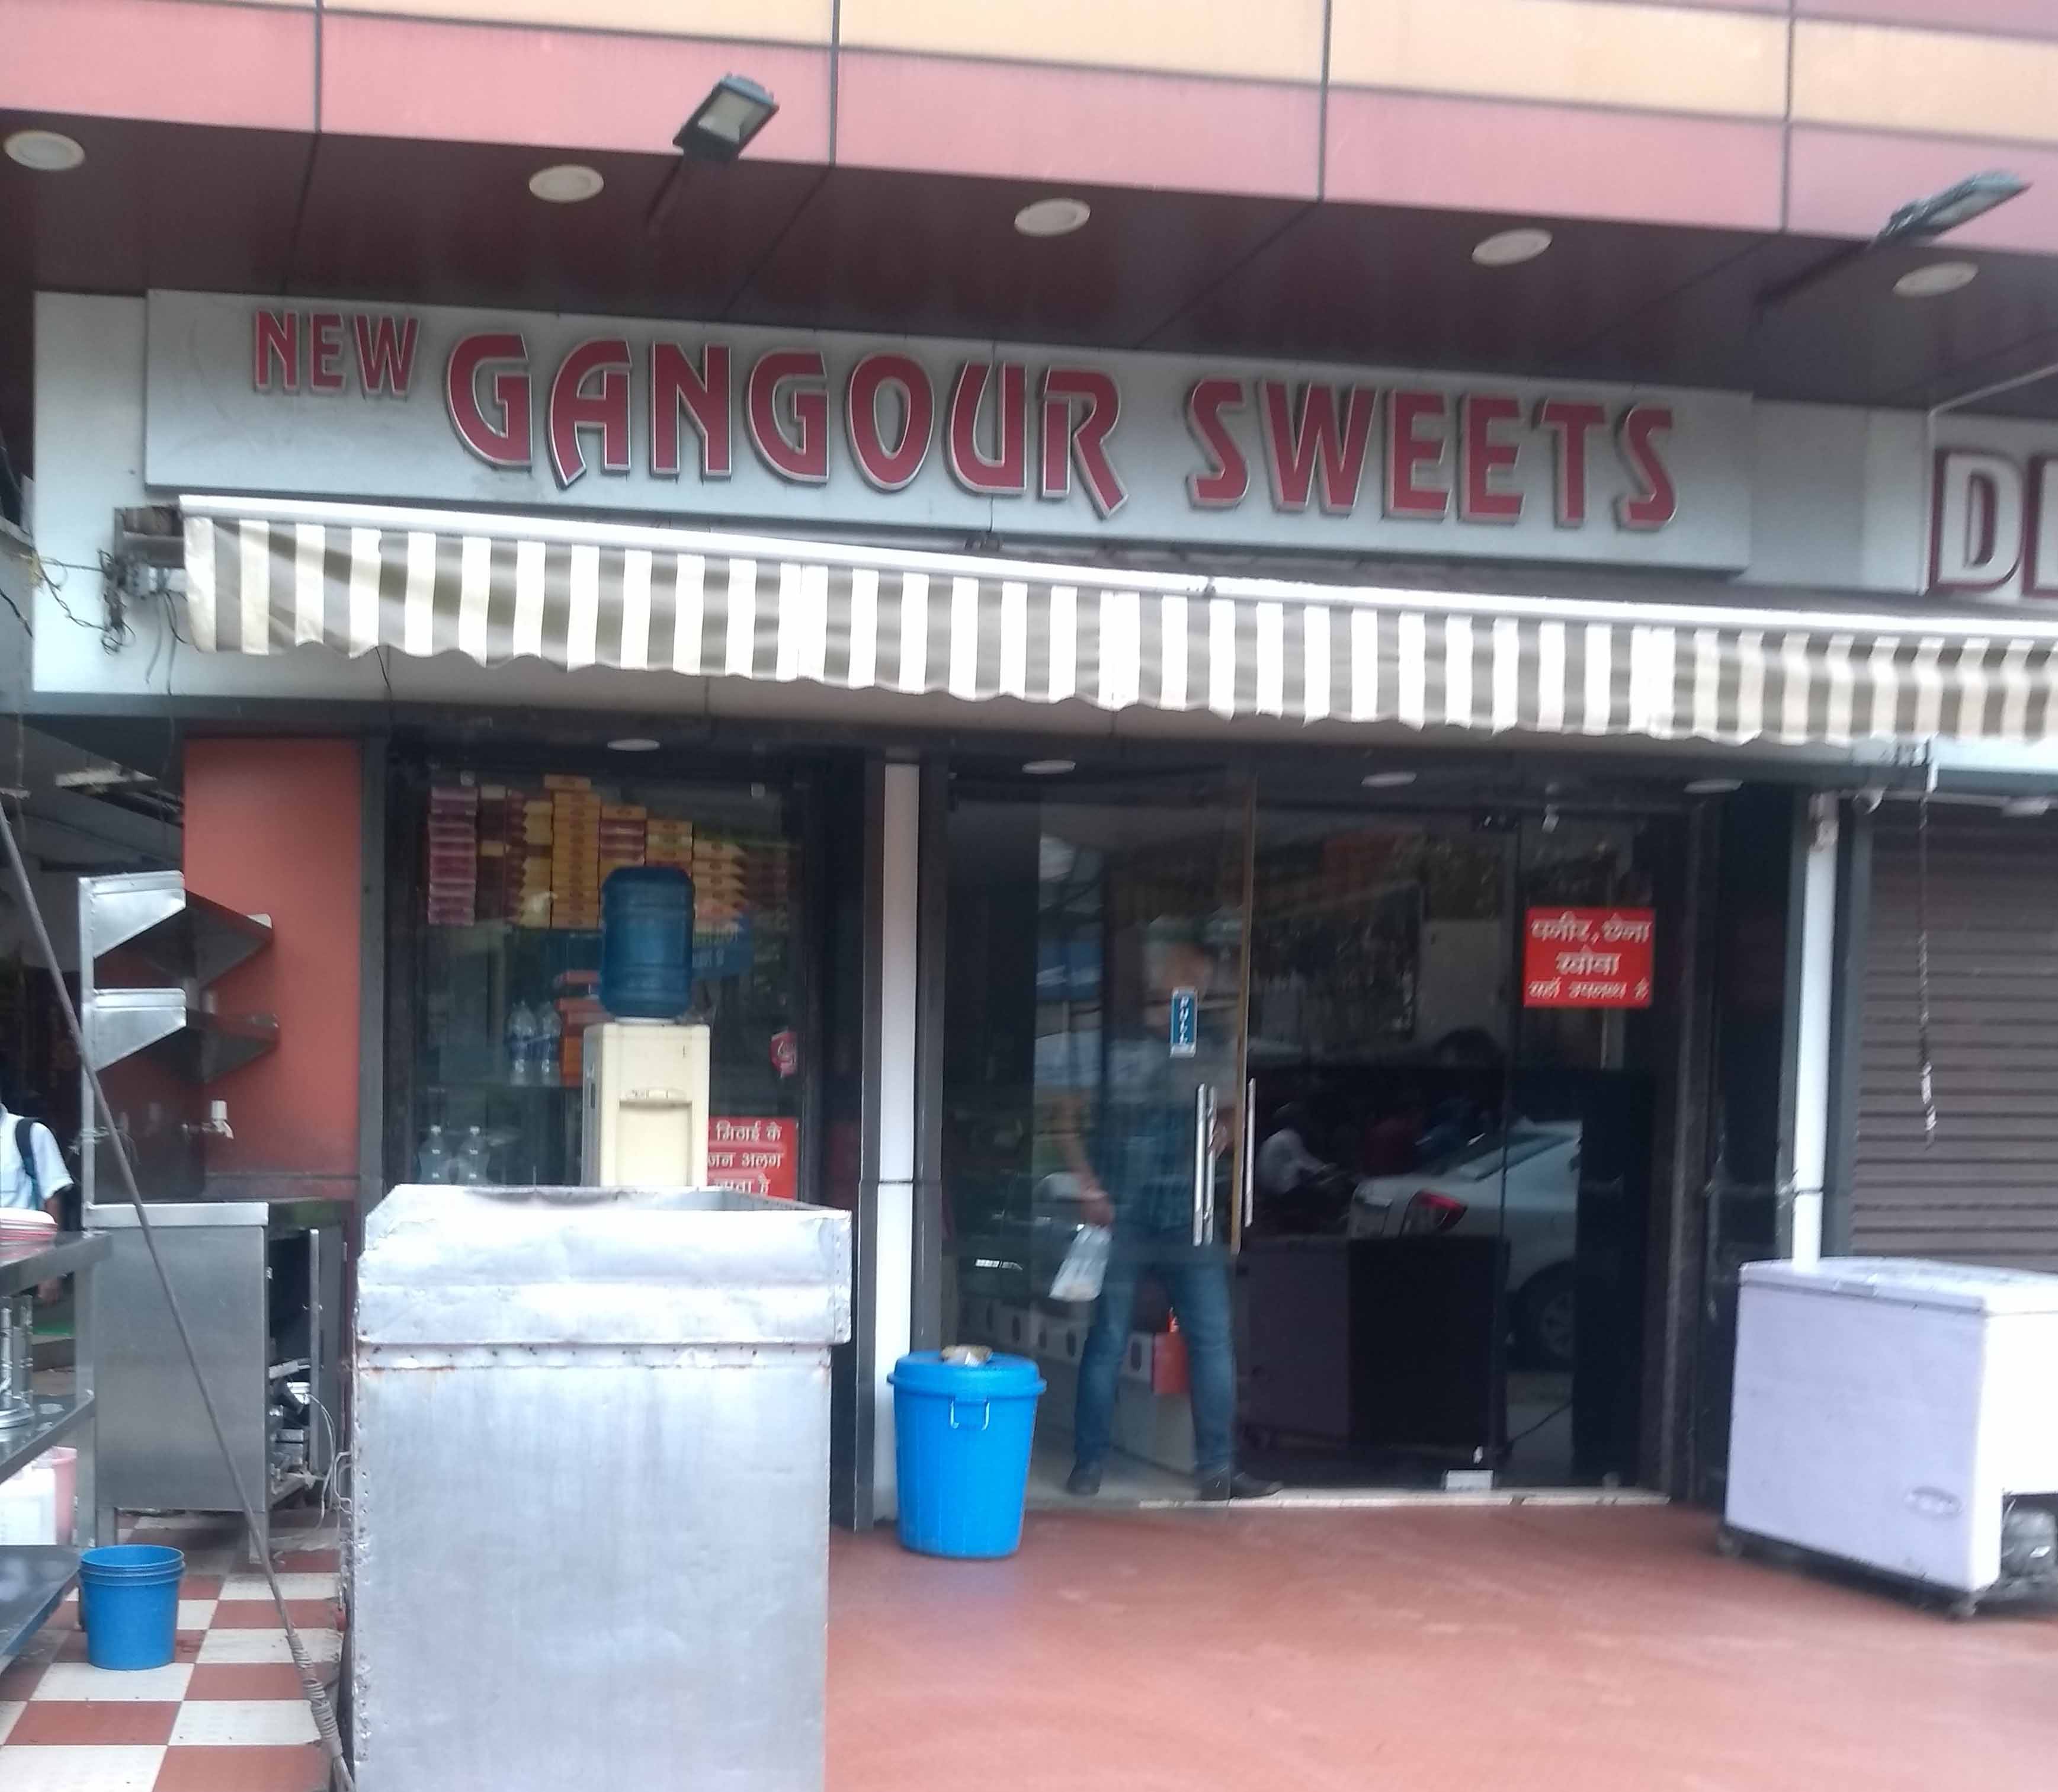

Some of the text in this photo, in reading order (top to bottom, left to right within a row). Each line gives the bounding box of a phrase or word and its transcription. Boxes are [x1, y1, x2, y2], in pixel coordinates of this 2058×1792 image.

[255, 309, 1678, 530] NEW GANGOUR SWEETS
[767, 1121, 783, 1142] के
[742, 1152, 785, 1168] अलग
